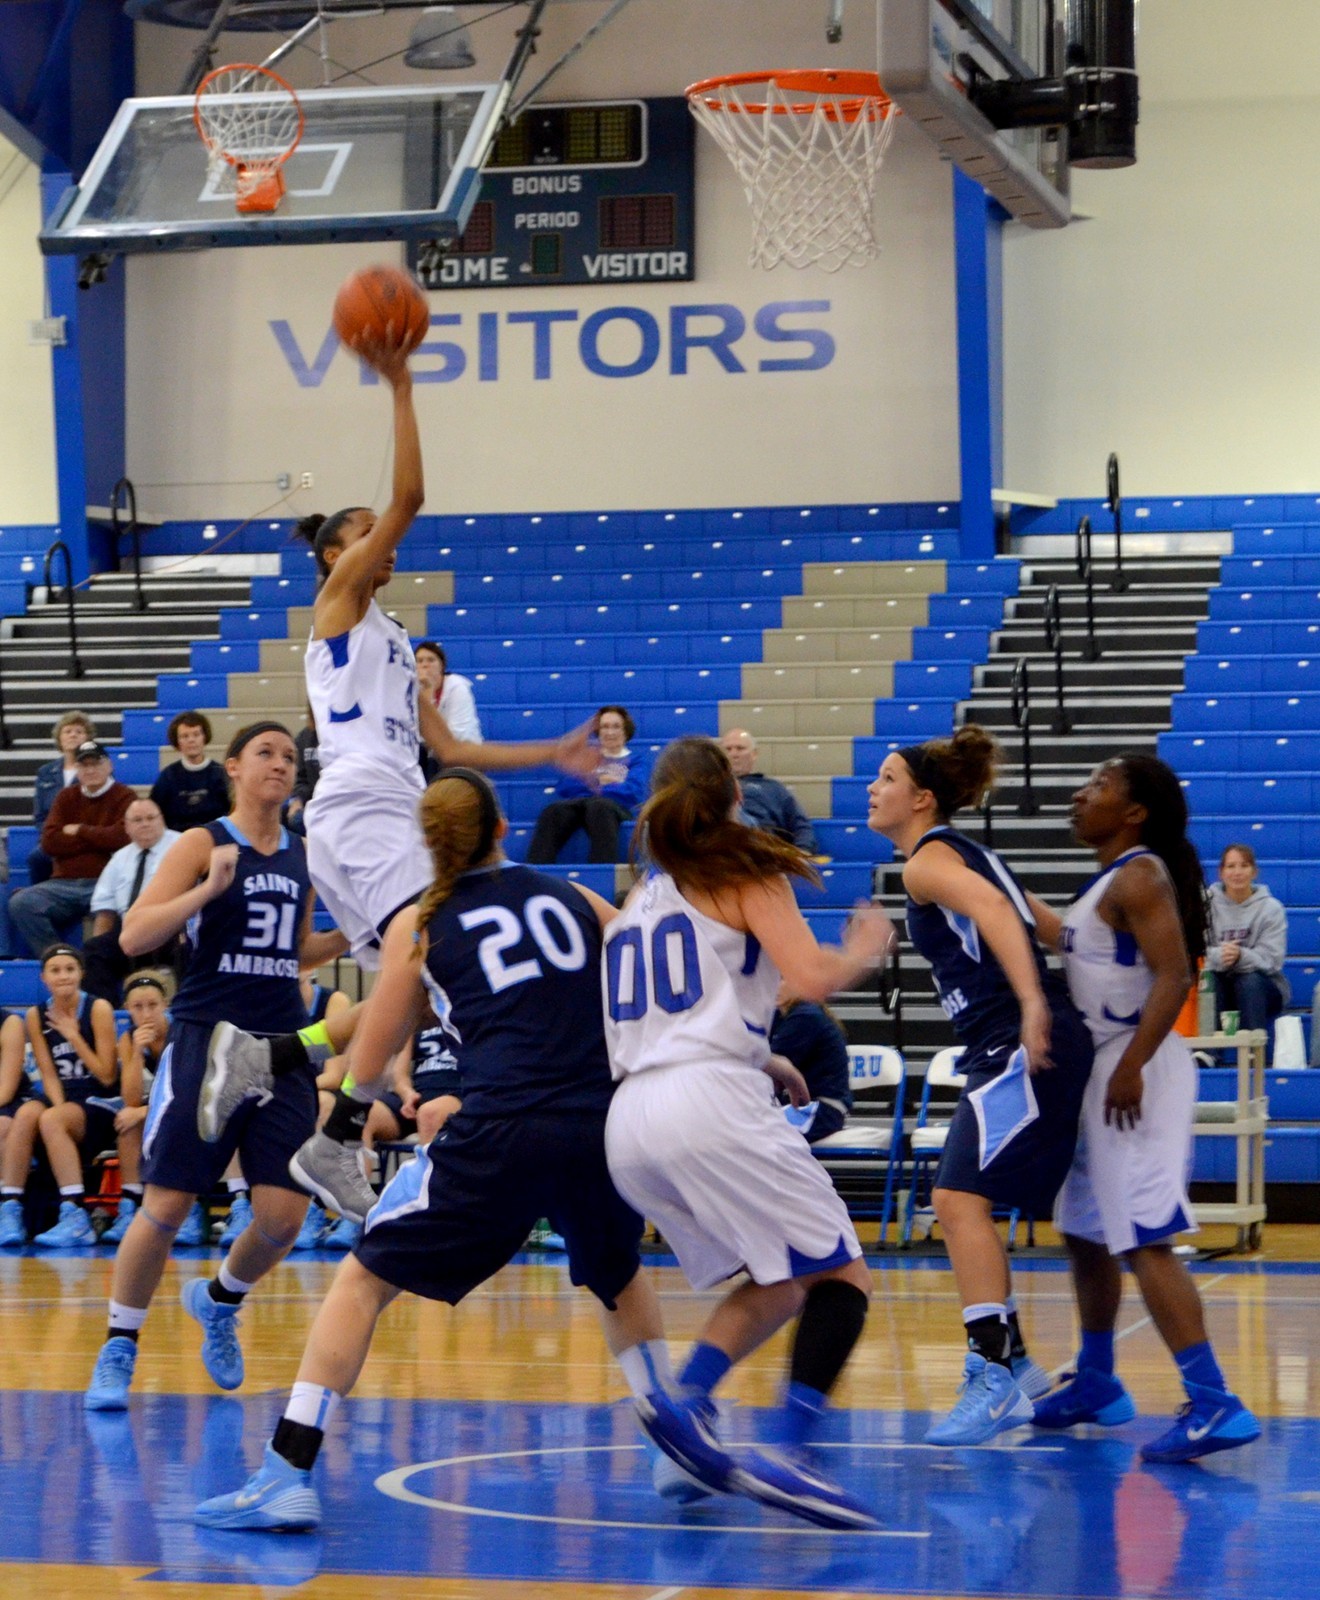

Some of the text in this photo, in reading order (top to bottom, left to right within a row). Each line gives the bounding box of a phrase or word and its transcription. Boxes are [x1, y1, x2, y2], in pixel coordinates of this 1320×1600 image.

[513, 175, 582, 195] BONUS
[515, 212, 580, 229] PERIOD
[582, 251, 688, 278] VISITOR
[244, 873, 299, 899] SAINT
[242, 901, 296, 950] 31
[457, 895, 586, 994] 20
[605, 912, 704, 1023] 00
